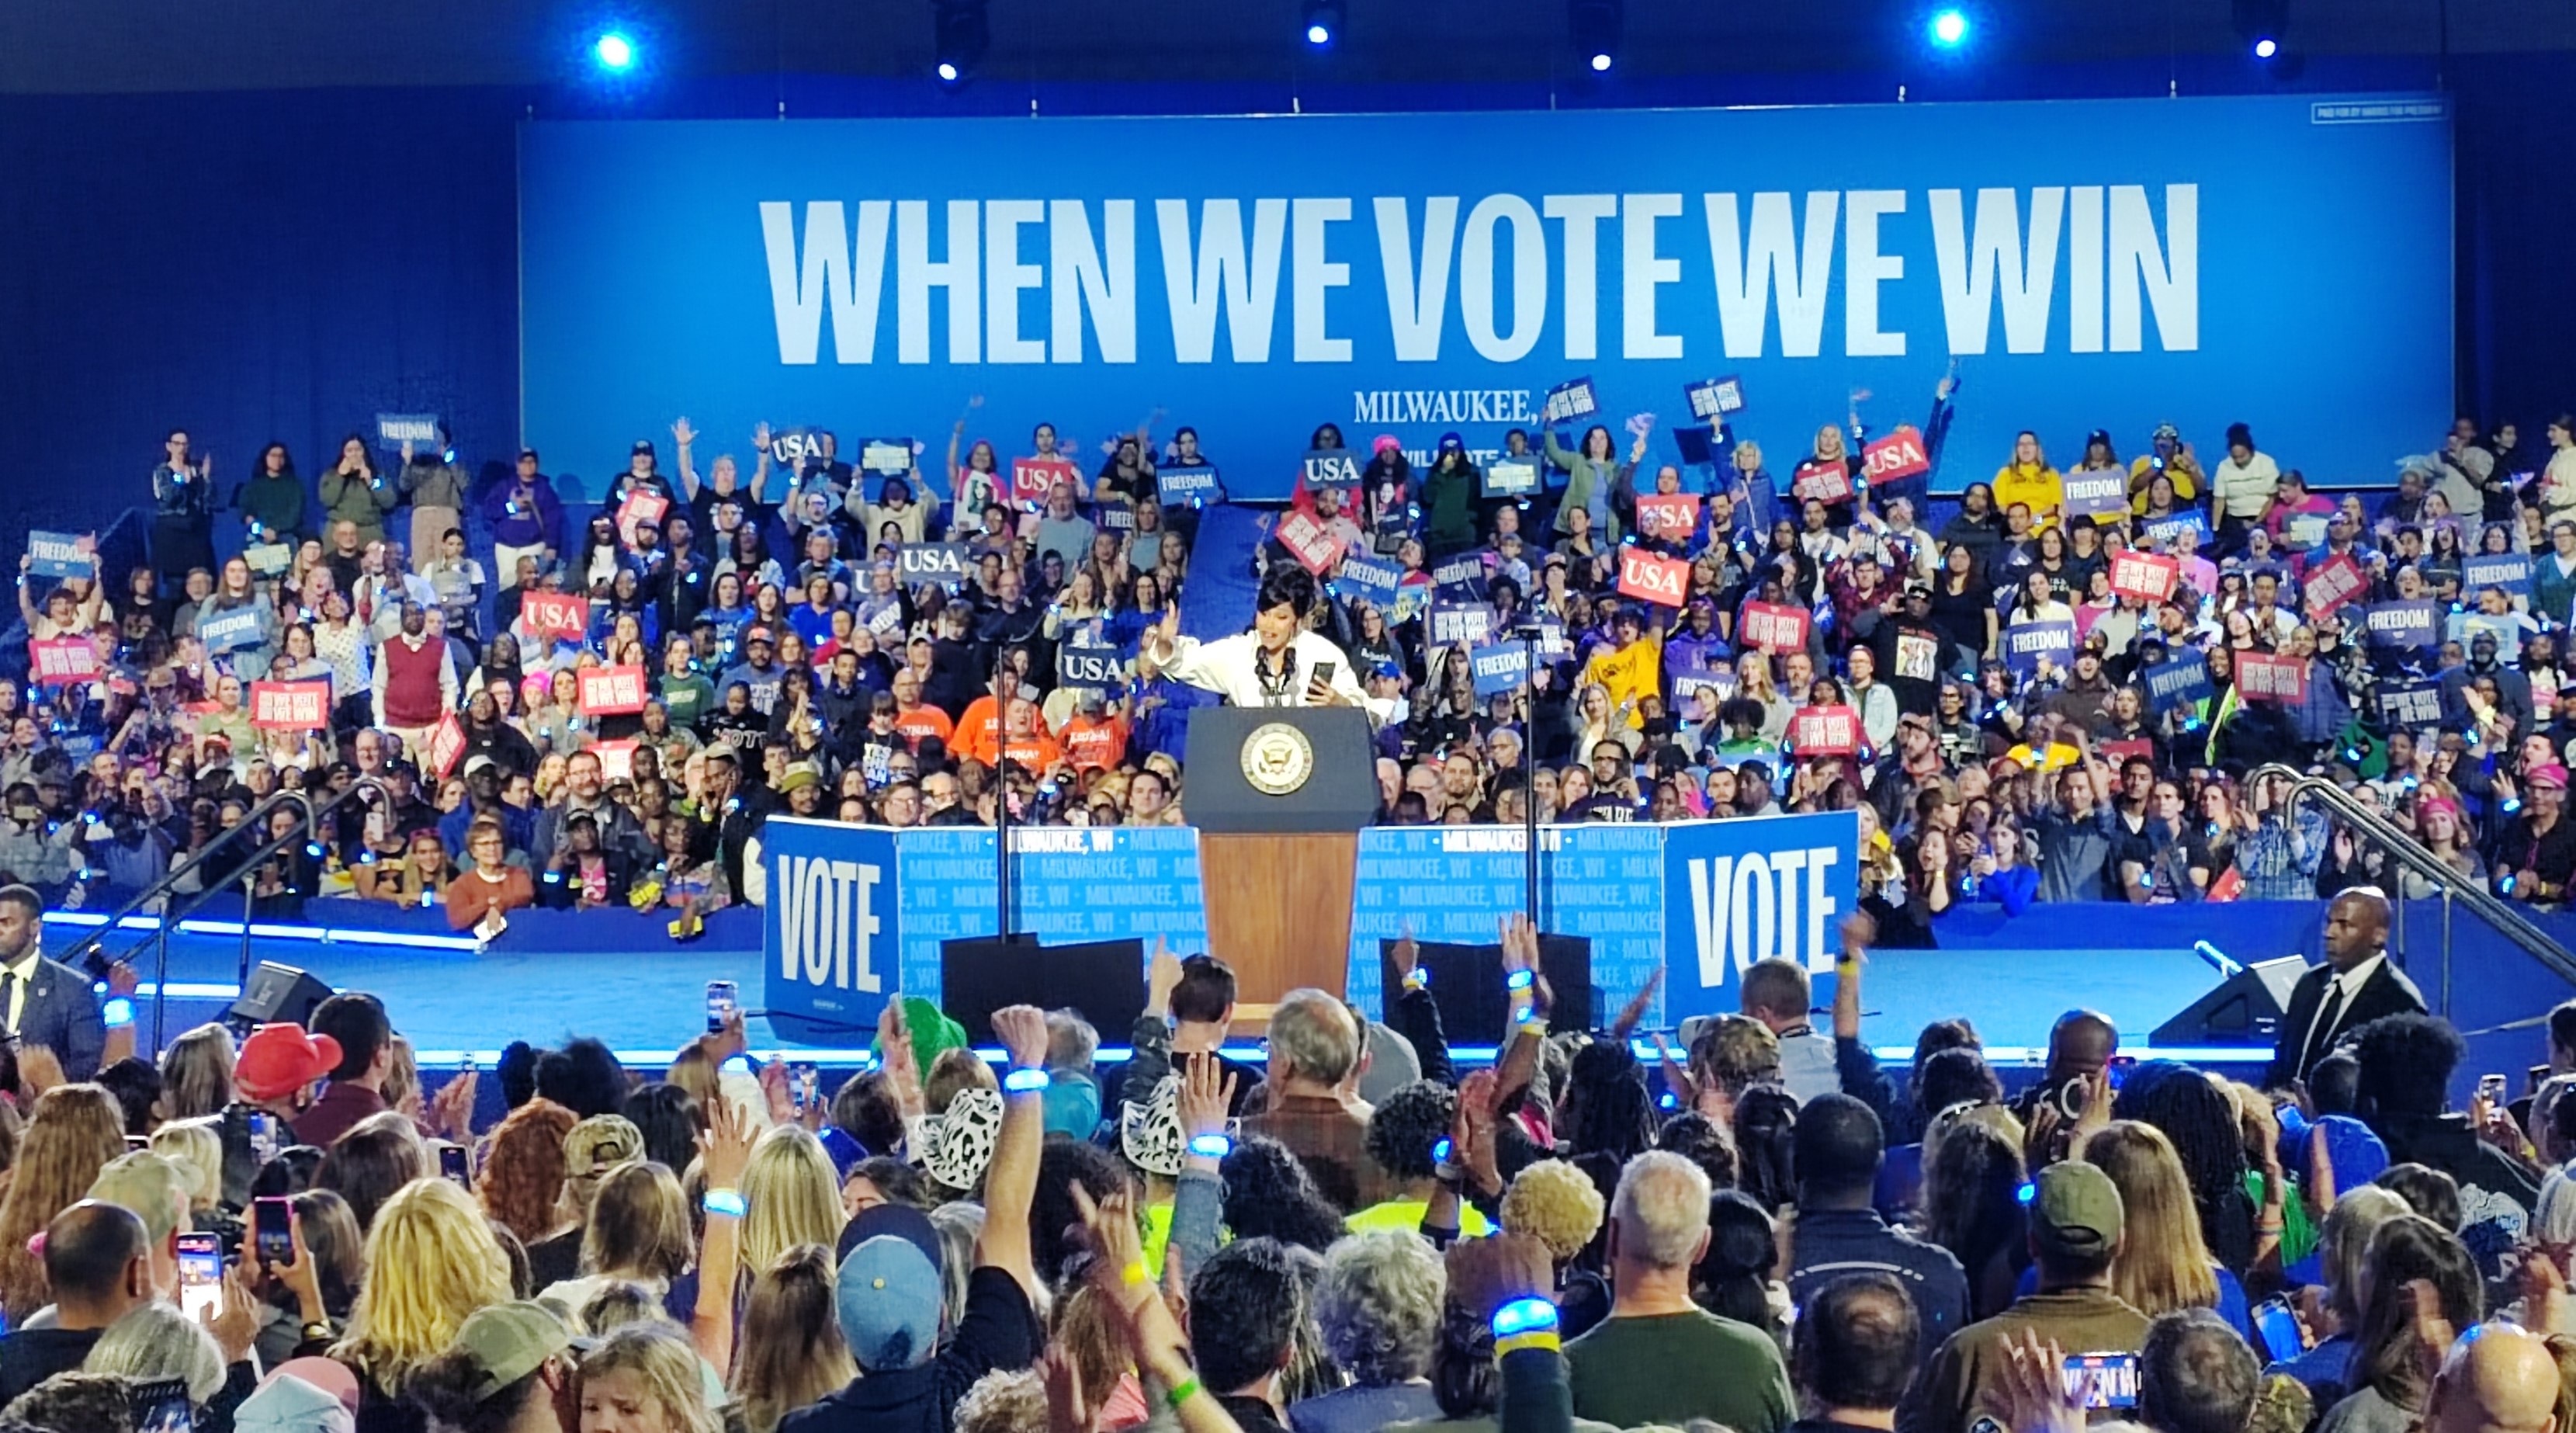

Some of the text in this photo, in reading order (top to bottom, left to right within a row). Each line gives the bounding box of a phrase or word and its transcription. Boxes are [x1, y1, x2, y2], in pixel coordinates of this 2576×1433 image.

[760, 184, 2198, 363] WHEN WE VOTE WE WIN
[1354, 390, 1539, 425] MILWAUKEE,
[381, 420, 435, 440] FREEDOM
[772, 433, 821, 462] USA
[1868, 439, 1922, 474] USA
[1305, 456, 1360, 482] USA
[1161, 474, 1214, 494] FREEDOM
[2066, 478, 2122, 499] FREEDOM
[1105, 509, 1135, 529] FREE
[903, 548, 961, 573] USA
[1433, 558, 1482, 585] FREEDOM
[1343, 557, 1398, 592] FREEDOM
[1625, 556, 1681, 595] USA
[2468, 563, 2526, 585] FREEDOM
[202, 611, 255, 640] FREEDOM
[526, 601, 582, 631] USA
[2368, 609, 2430, 630] FREEDOM
[2012, 630, 2068, 654] FREEDOM
[1064, 654, 1124, 682] USA
[1476, 650, 1527, 677] FREEDO
[1676, 676, 1732, 702] FREOM
[2151, 663, 2204, 697] FREEDOM
[1008, 830, 1089, 855] LWAUKEE,
[1090, 830, 1114, 852] WI
[1404, 831, 1426, 852] WI
[1041, 857, 1133, 881] MILWAUKEE,
[1135, 857, 1157, 879] WI
[1449, 858, 1471, 880] WI
[1583, 857, 1606, 879] WI
[915, 887, 937, 908] WI
[1047, 885, 1070, 907] WI
[1085, 884, 1178, 908] MILWAUKEE,
[1361, 886, 1382, 907] WI
[1399, 885, 1490, 908] MILWAUKEE,
[1494, 884, 1516, 907] WI
[1628, 884, 1651, 906] WI
[778, 853, 882, 994] VOTE
[959, 913, 981, 935] WI
[1091, 911, 1114, 933] WI
[1687, 846, 1838, 988] VOTE
